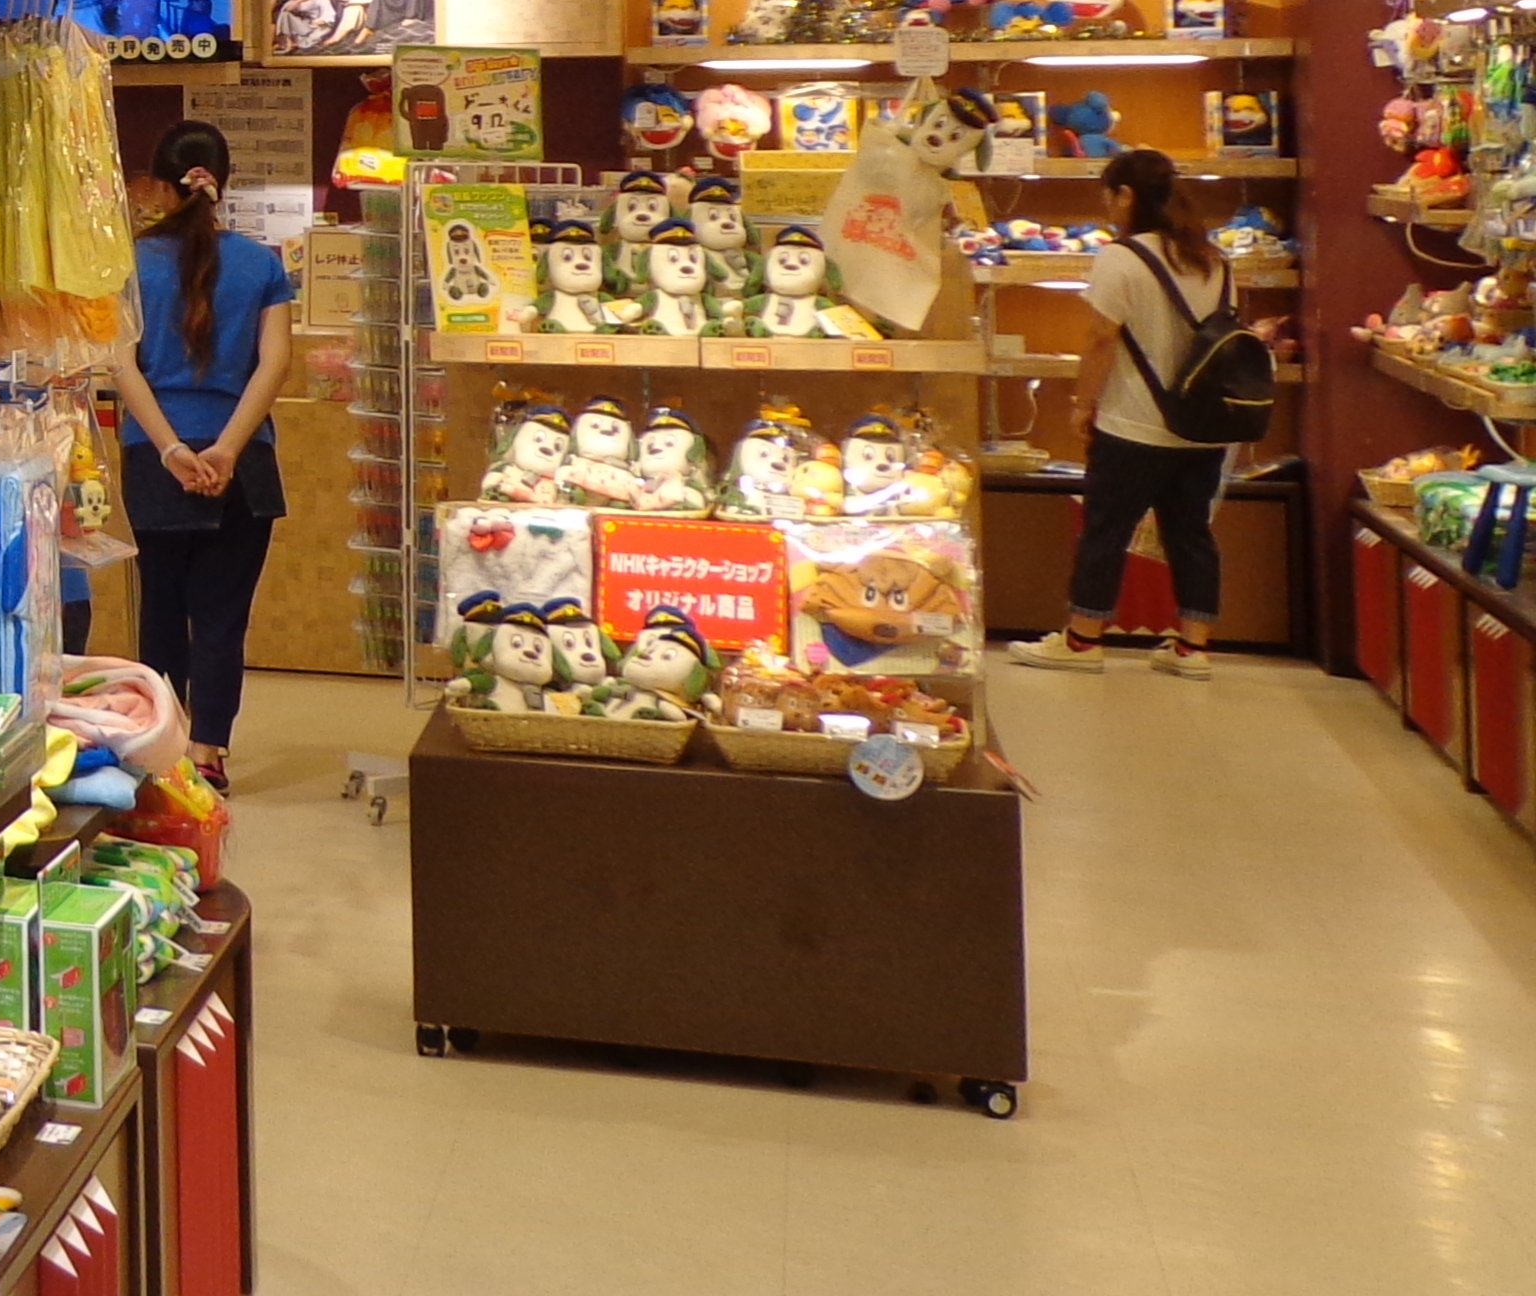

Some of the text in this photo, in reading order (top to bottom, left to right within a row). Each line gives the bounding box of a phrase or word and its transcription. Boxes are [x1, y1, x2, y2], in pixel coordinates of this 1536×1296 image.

[610, 552, 774, 584] NHKキャラクターショップ
[626, 589, 756, 621] オリジナル商品
